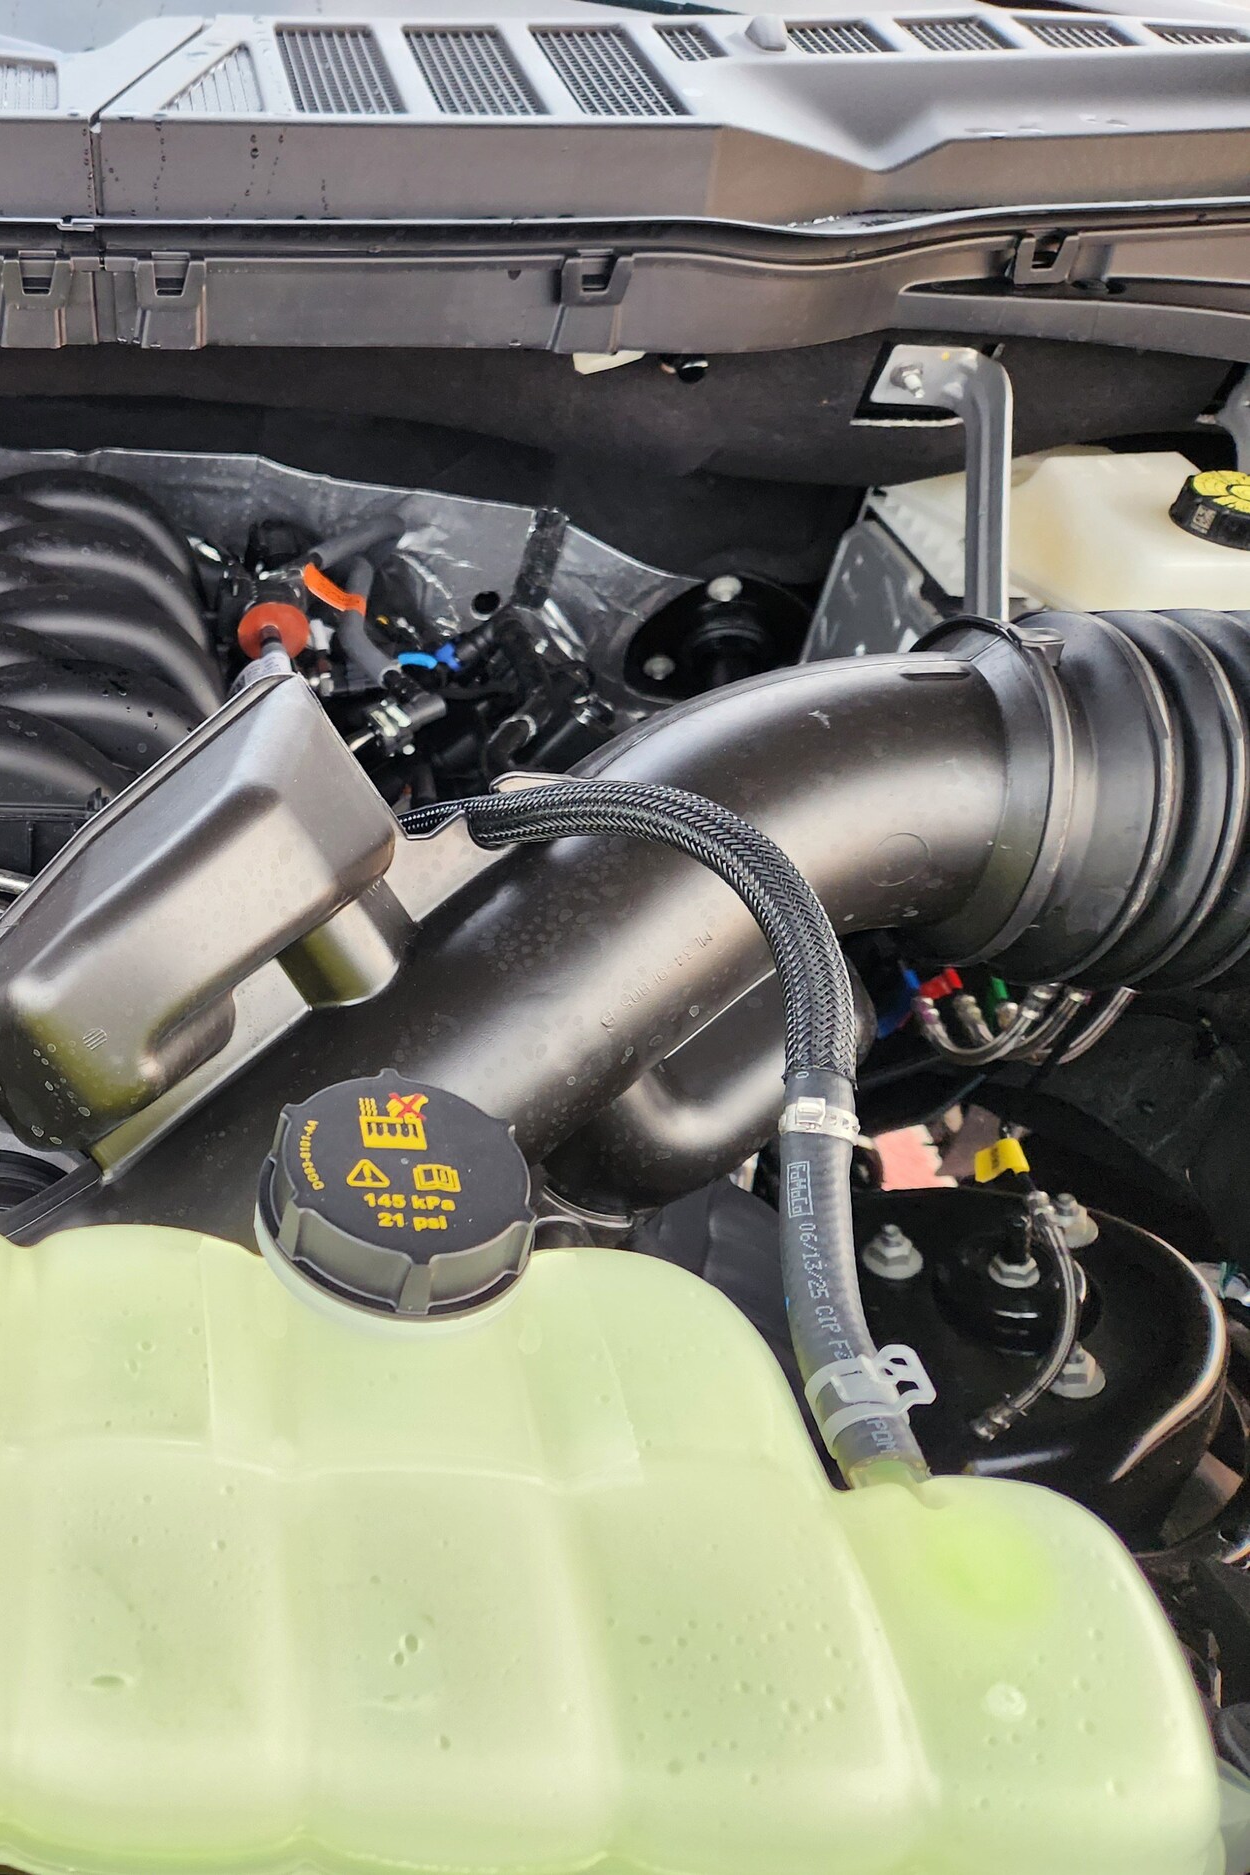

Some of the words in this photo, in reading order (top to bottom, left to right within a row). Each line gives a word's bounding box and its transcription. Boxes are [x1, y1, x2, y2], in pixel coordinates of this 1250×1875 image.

[363, 1192, 407, 1209] 145
[411, 1194, 456, 1211] kPa
[788, 1161, 813, 1217] FoMoCo
[377, 1212, 405, 1228] 21
[412, 1215, 448, 1232] psi
[799, 1222, 830, 1300] 06/13/25
[815, 1305, 842, 1333] CIP
